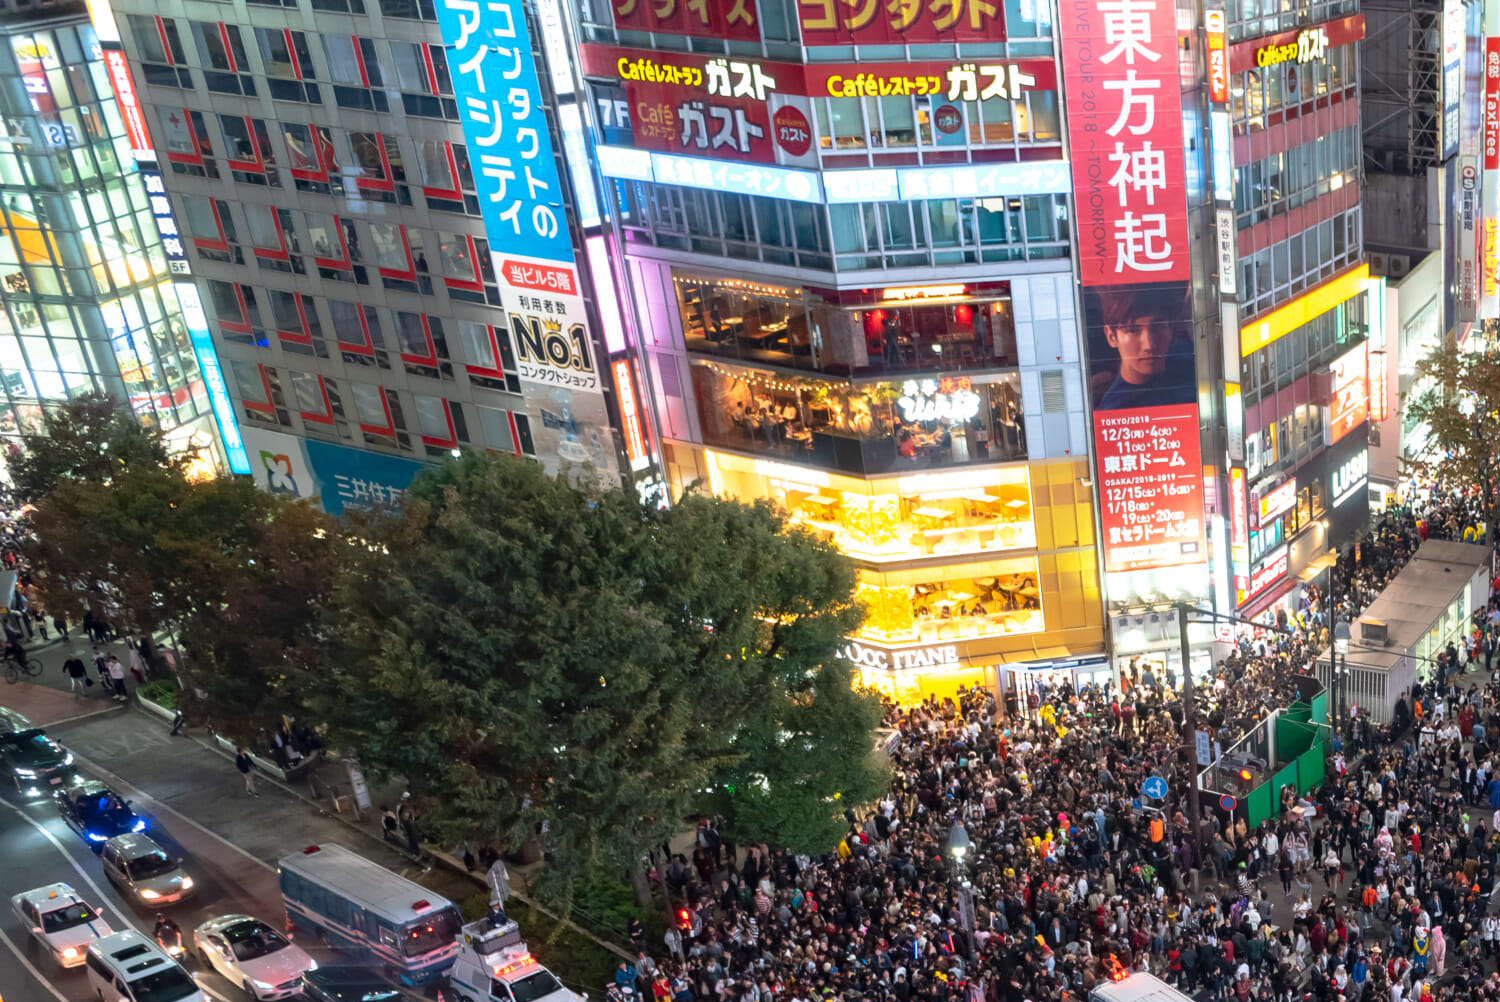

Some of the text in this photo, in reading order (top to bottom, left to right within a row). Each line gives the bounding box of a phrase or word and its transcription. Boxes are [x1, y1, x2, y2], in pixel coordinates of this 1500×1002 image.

[1078, 39, 1093, 85] TOUR
[1297, 28, 1329, 64] ガスト
[704, 58, 776, 101] ガスト
[947, 64, 1036, 102] ガスト
[445, 0, 522, 234] アイシティ
[487, 2, 559, 239] コンタクトの
[636, 102, 674, 126] Café
[677, 101, 764, 153] ガスト
[1081, 90, 1098, 133] 2018
[1486, 90, 1499, 156] TaxFree
[641, 124, 676, 140] レストラン
[780, 127, 809, 142] ガスト
[1096, 0, 1174, 273] 東方神起
[171, 263, 187, 273] 5F
[510, 265, 571, 291] 当ビル5階
[519, 296, 567, 315] 利用者数
[508, 312, 595, 373] No.1
[519, 365, 597, 389] コンタクトショップ
[1101, 416, 1150, 426] TOKYO/2018
[1104, 451, 1186, 473] 東京ドーム
[1332, 449, 1368, 498] LUSH
